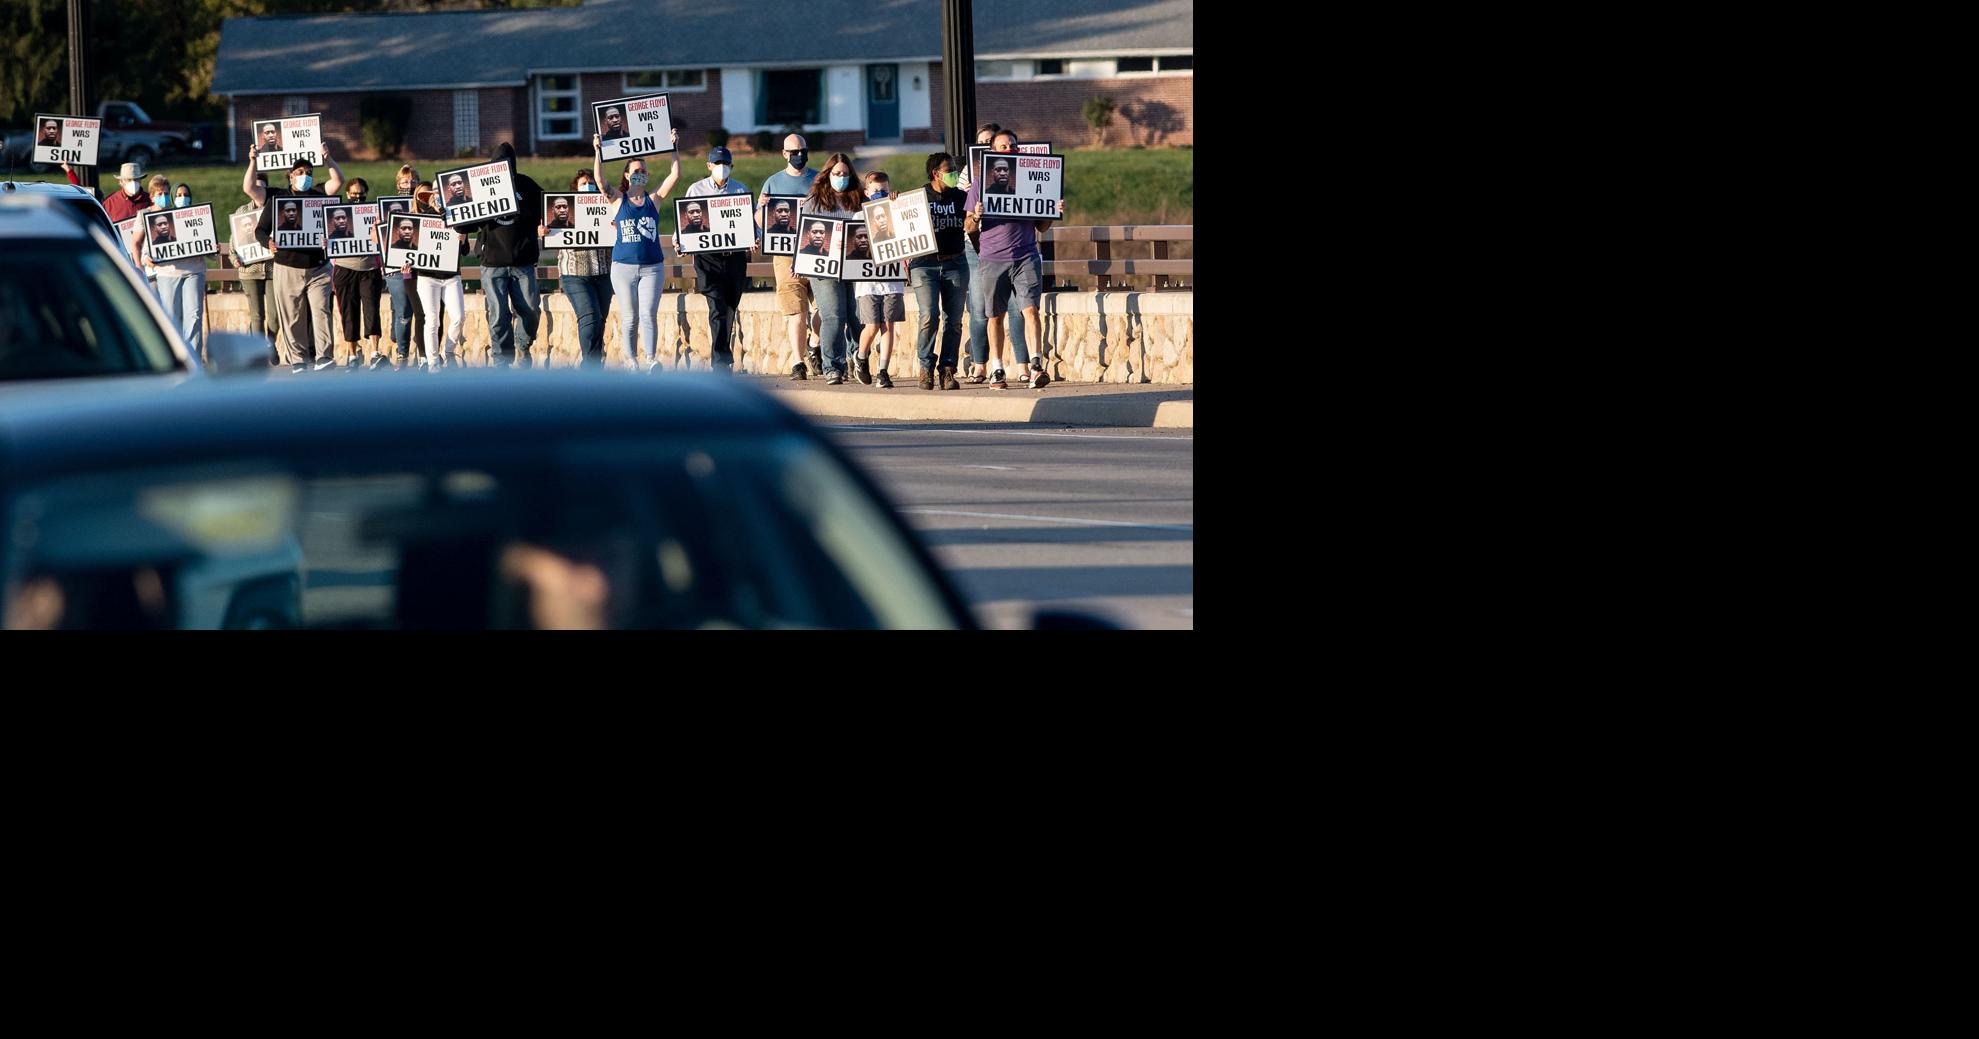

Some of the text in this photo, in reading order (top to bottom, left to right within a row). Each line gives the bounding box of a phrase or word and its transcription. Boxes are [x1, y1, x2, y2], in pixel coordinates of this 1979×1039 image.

[628, 98, 666, 111] GEORGE FLOYD
[638, 111, 659, 121] WAS
[647, 123, 654, 132] A
[72, 130, 90, 138] WAS
[292, 129, 311, 138] WAS
[299, 140, 305, 148] A
[619, 136, 656, 154] SON
[50, 149, 81, 162] SON
[1019, 159, 1060, 169] GEORGE FLOYD
[470, 164, 508, 177] GEORGE FLOYD
[1028, 171, 1050, 181] WAS
[480, 176, 501, 187] WAS
[490, 188, 496, 196] A
[1035, 184, 1042, 194] A
[577, 196, 598, 204] GEORGE
[709, 197, 751, 208] GEORGE FLOYD
[355, 206, 373, 214] GEORGE
[450, 198, 511, 222] FRIEND
[987, 196, 1056, 215] MENTOR
[586, 207, 607, 216] WAS
[720, 209, 742, 218] WAS
[900, 208, 919, 221] WAS
[184, 218, 204, 228] WAS
[422, 219, 442, 229] GEORGE
[593, 218, 600, 227] A
[729, 220, 736, 229] A
[909, 222, 915, 232] A
[193, 229, 199, 237] A
[430, 231, 450, 240] WAS
[563, 231, 599, 245] SON
[279, 233, 322, 246] ATHLE
[699, 233, 736, 249] SON
[155, 239, 213, 260] MENTOR
[435, 242, 442, 250] A
[877, 234, 929, 261] FRIEND
[405, 252, 440, 268] SON
[814, 258, 839, 275] SO
[862, 262, 900, 278] SON
